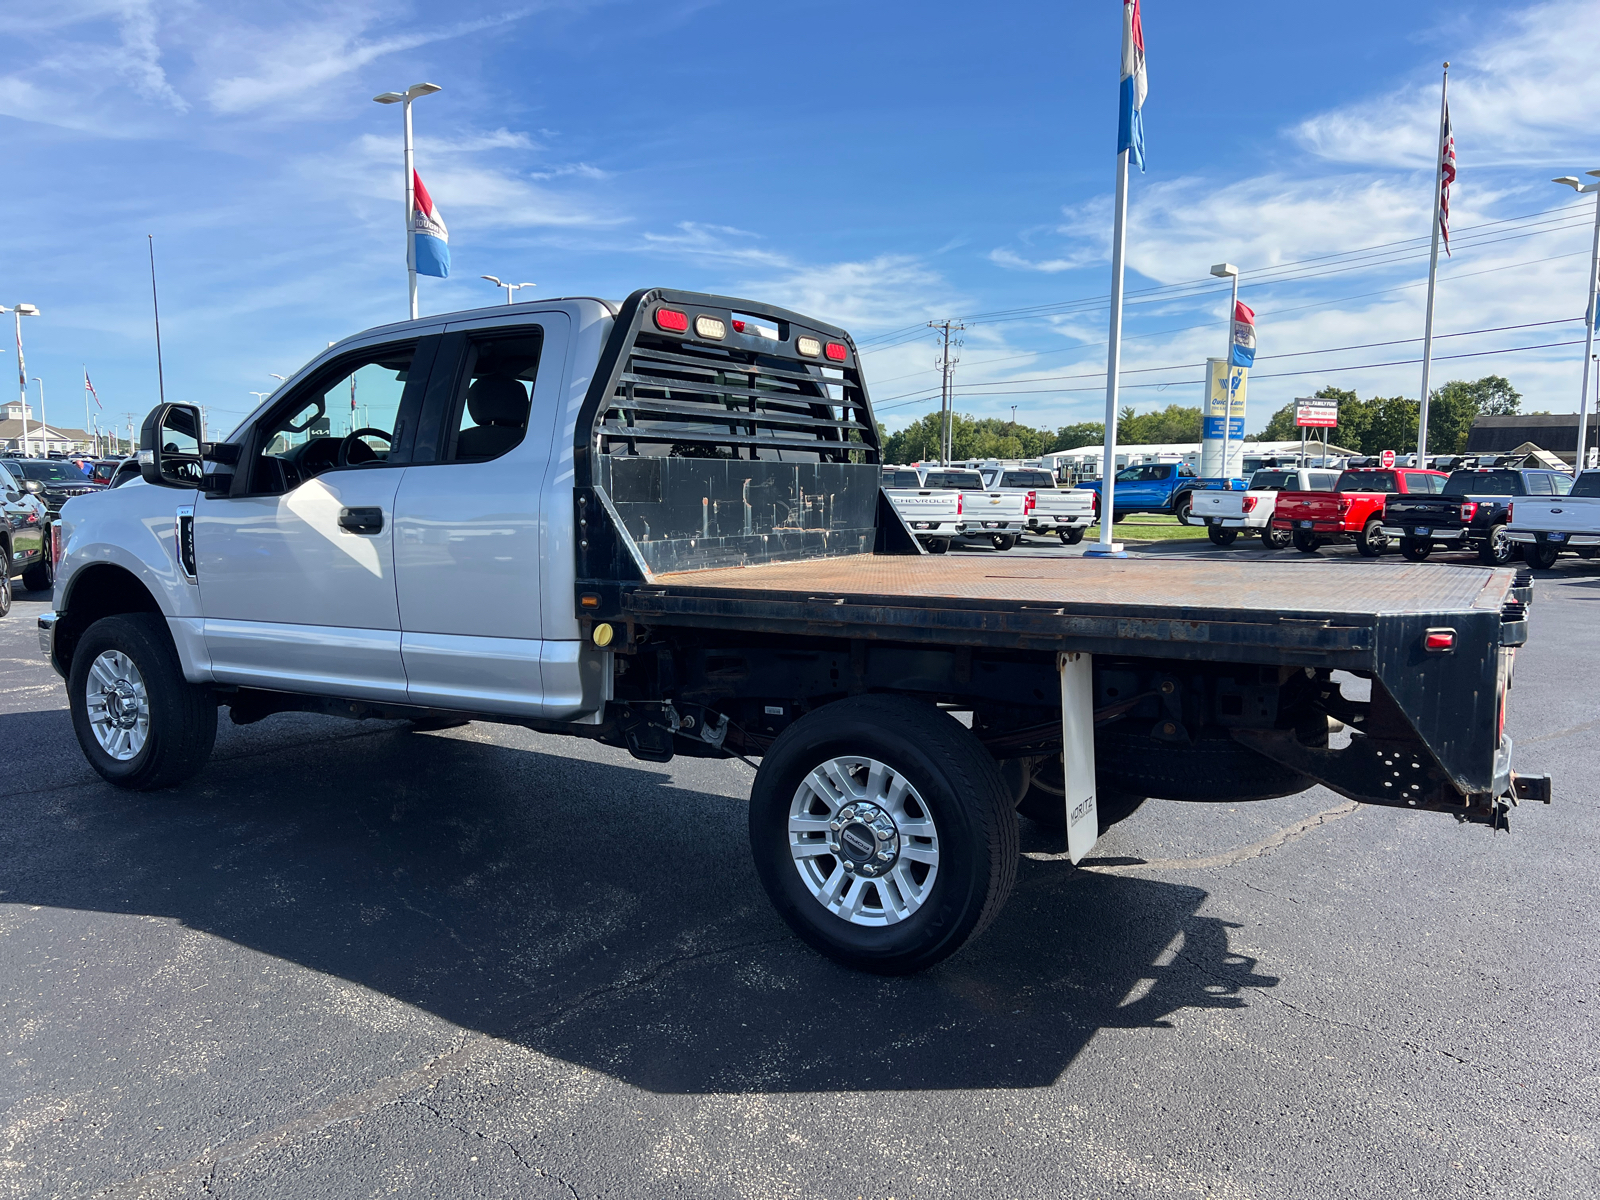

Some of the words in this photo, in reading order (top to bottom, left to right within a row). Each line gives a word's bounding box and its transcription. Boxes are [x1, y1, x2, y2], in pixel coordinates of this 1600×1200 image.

[416, 219, 439, 232] TOUGH
[1212, 398, 1227, 406] Quic
[1070, 796, 1093, 820] MORITZ
[846, 834, 870, 851] FORD
